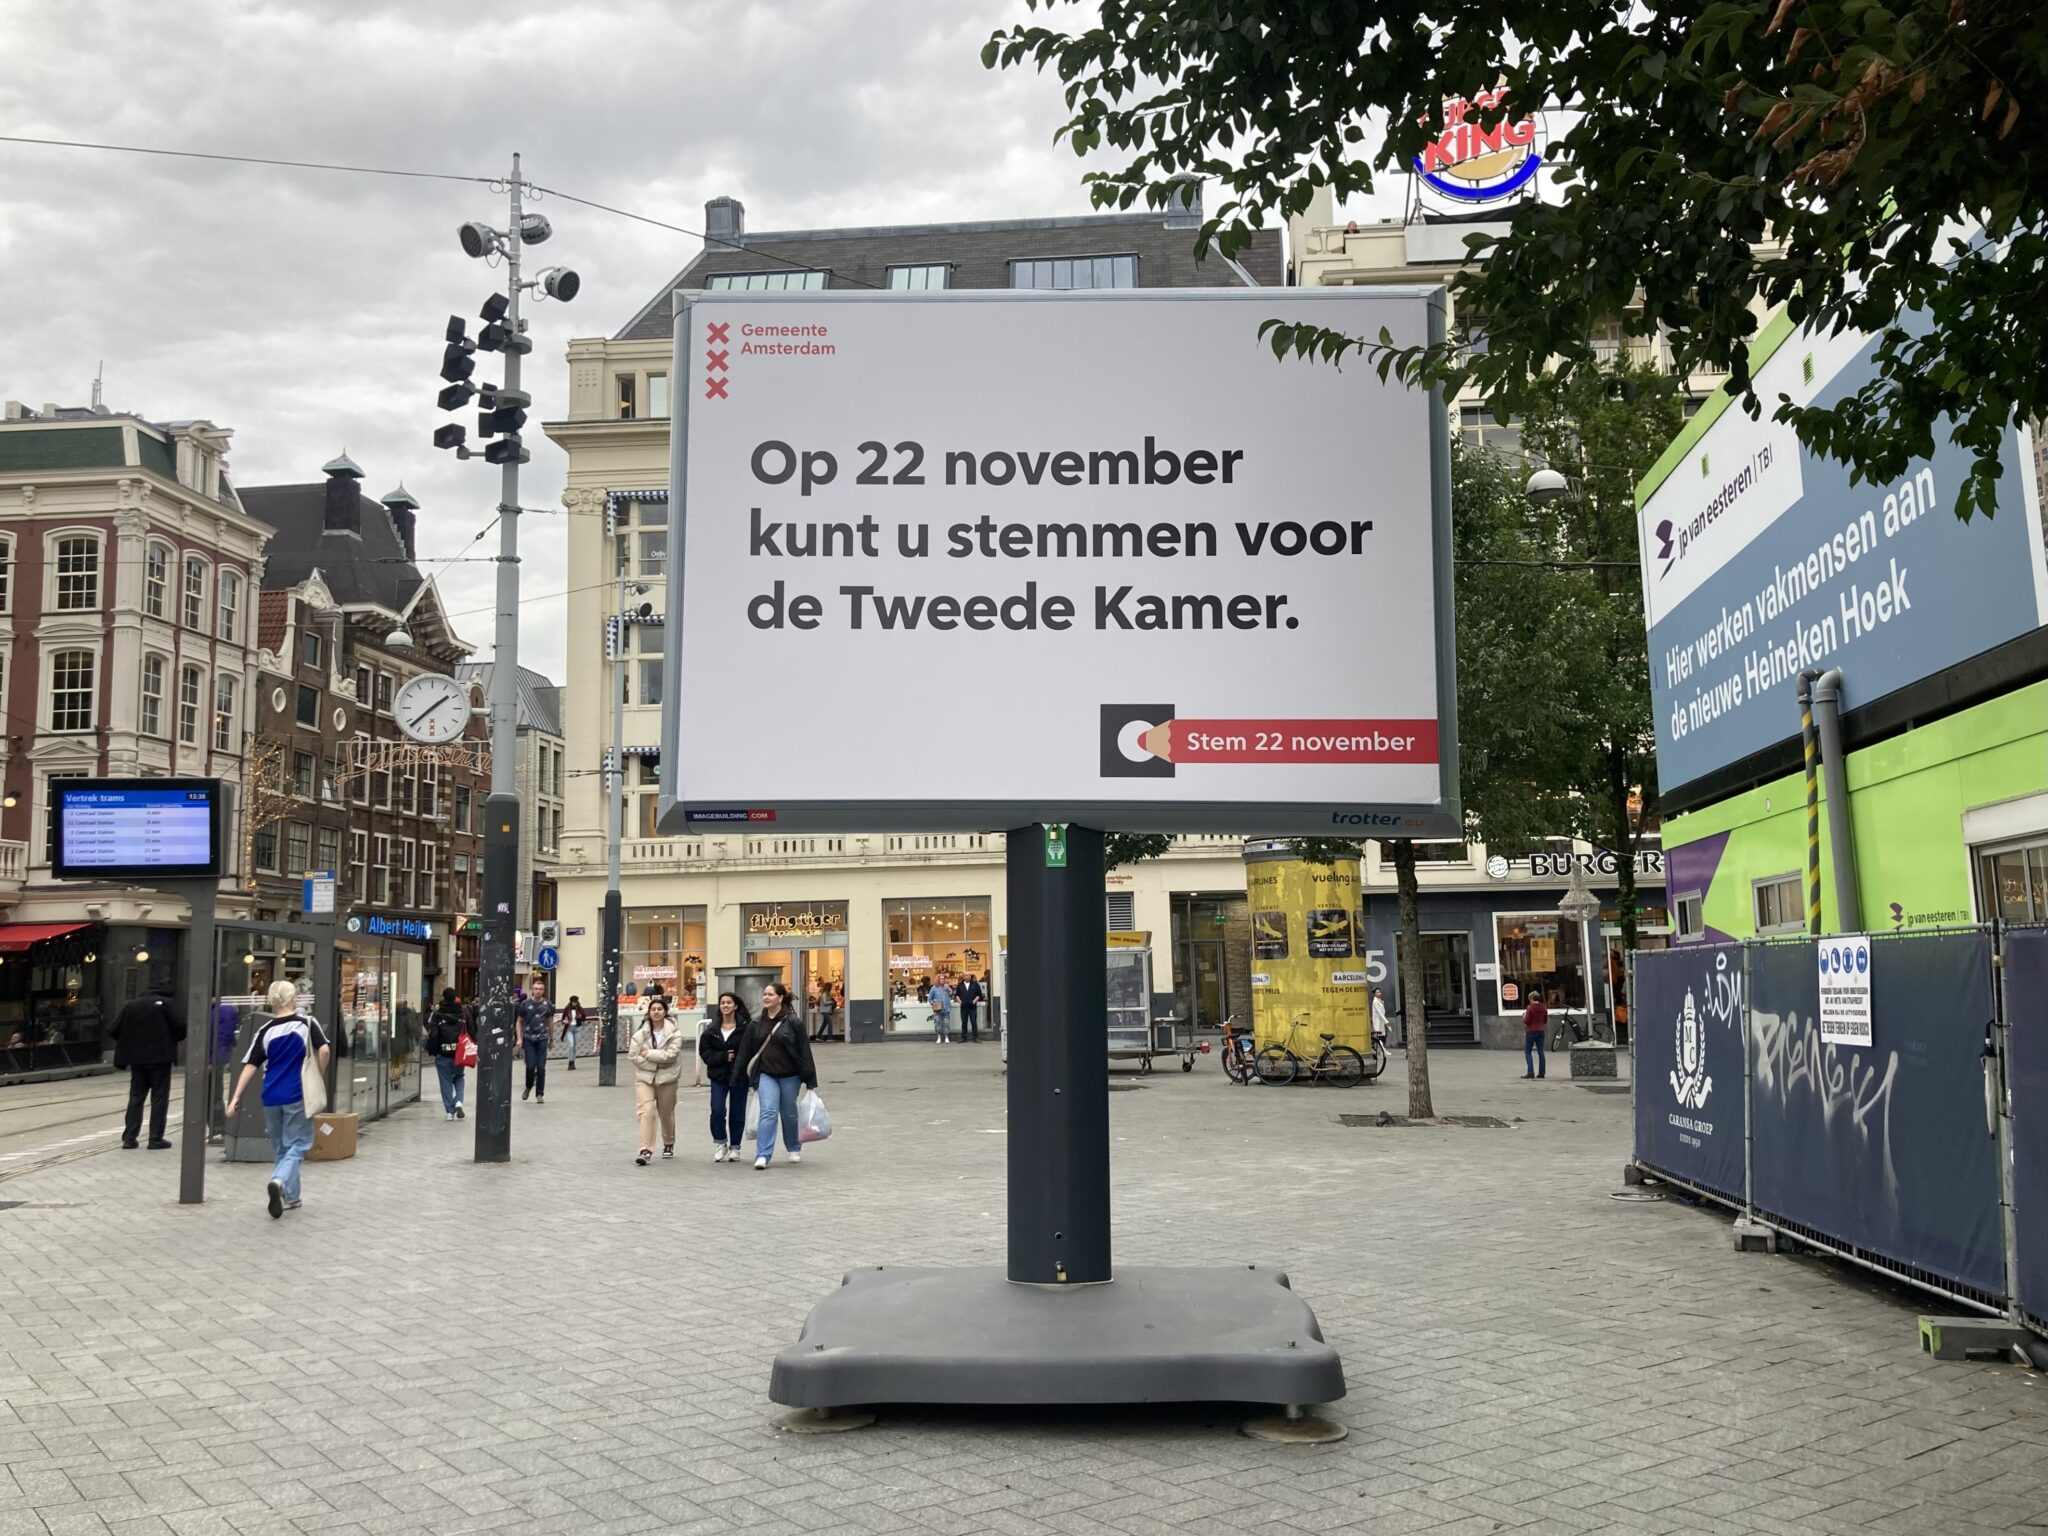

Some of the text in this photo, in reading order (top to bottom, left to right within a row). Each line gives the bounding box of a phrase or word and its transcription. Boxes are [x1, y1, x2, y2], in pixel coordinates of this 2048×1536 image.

[1424, 121, 1535, 174] KING
[741, 323, 828, 337] Gemeente
[741, 341, 836, 355] Amsterdam
[750, 436, 1244, 496] Op 22 november
[1688, 511, 1706, 541] van
[1706, 465, 1752, 524] eesteren
[1757, 442, 1773, 473] TBI
[750, 507, 1373, 558] kunt u stemmen voor
[1665, 466, 1937, 689] Hier werken vakmensen aan
[747, 580, 1299, 631] de Tweede Kamer.
[1671, 557, 1912, 741] de nieuwe Heineken Hoek
[1186, 731, 1416, 751] Stem 22 november
[66, 793, 98, 802] Vertrek
[100, 794, 125, 802] trams
[1529, 851, 1662, 877] BURGR
[1312, 871, 1350, 886] vueling
[368, 917, 400, 934] Albert
[751, 911, 841, 930] flying tiger
[1914, 914, 1926, 924] van
[1926, 910, 1957, 923] eesteren
[1366, 950, 1387, 983] 5
[1668, 1113, 1714, 1136] CARANSA GROEP
